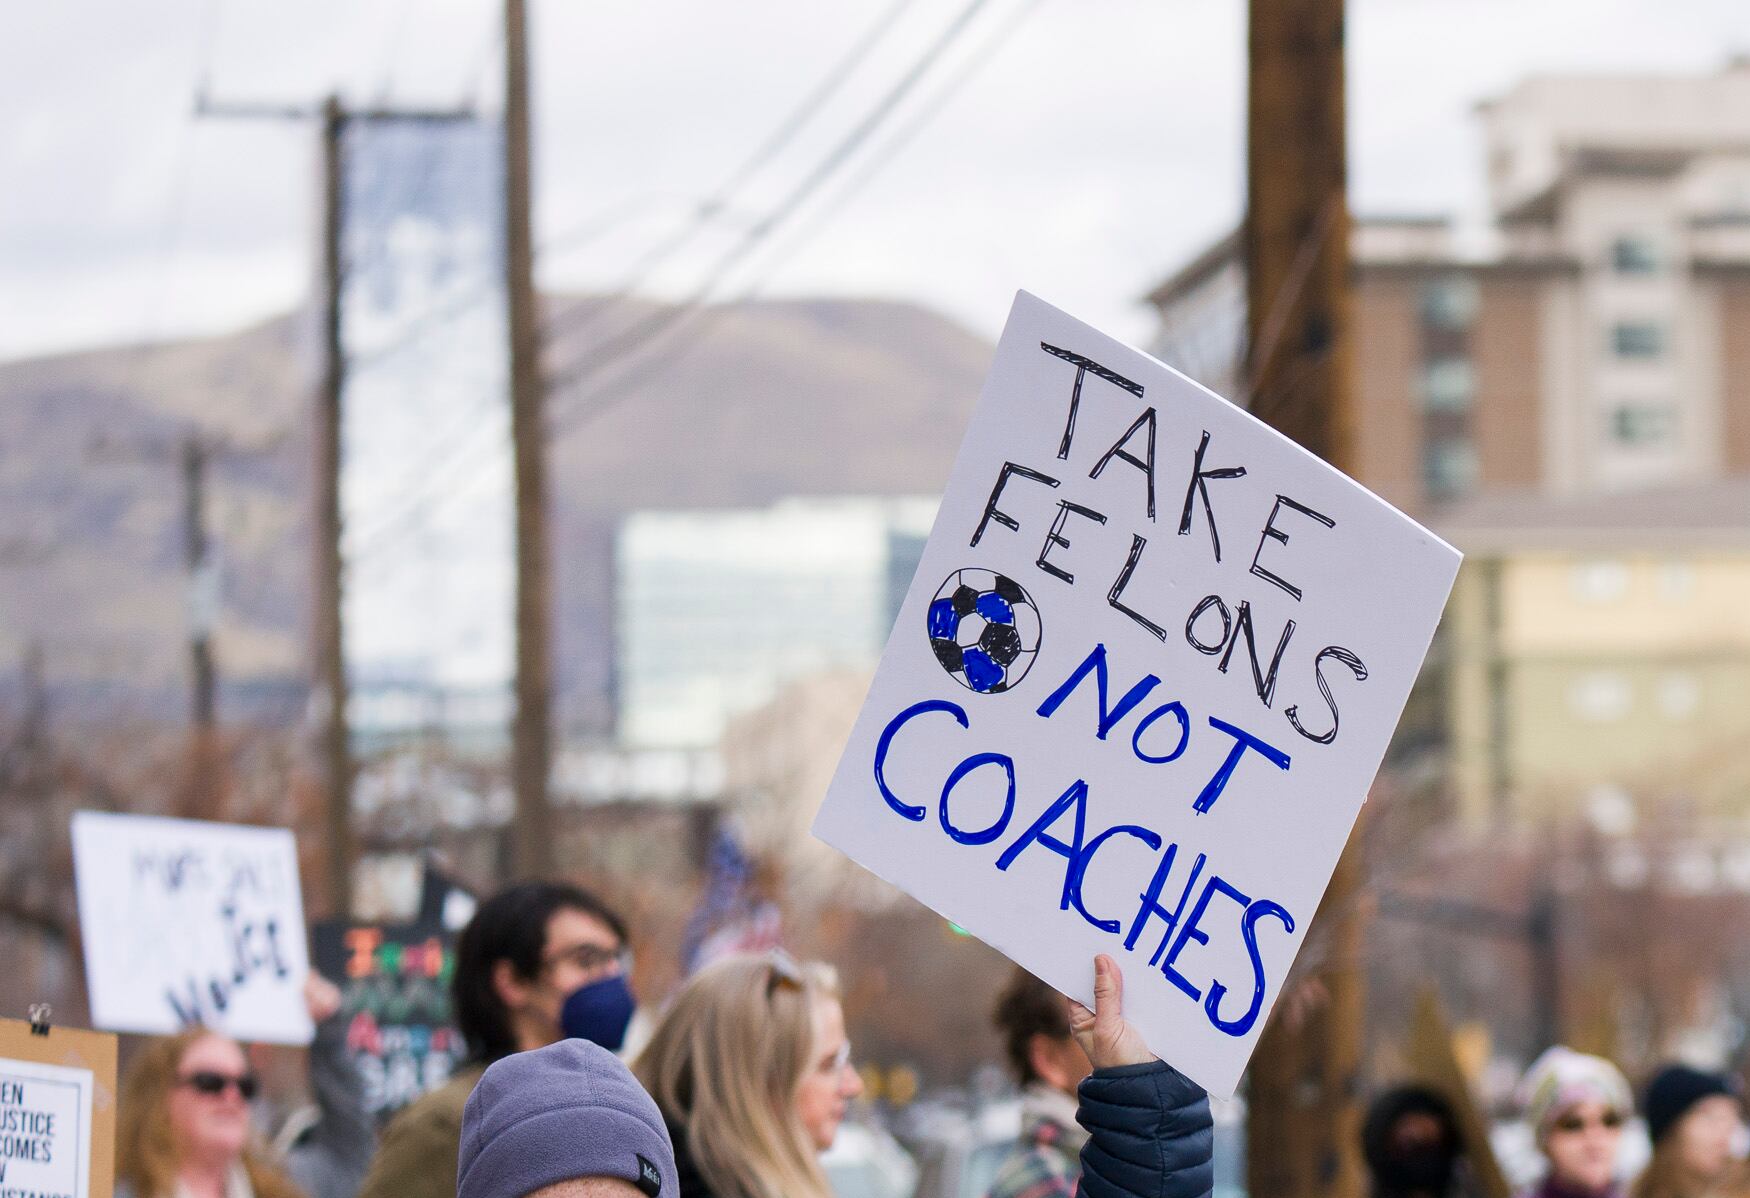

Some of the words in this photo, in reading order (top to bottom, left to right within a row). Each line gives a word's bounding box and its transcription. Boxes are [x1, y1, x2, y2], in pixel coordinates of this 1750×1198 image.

[969, 461, 1369, 745] FELONS
[1040, 341, 1337, 602] TAKE
[1036, 643, 1292, 816] NOT
[873, 699, 1297, 1038] COACHES
